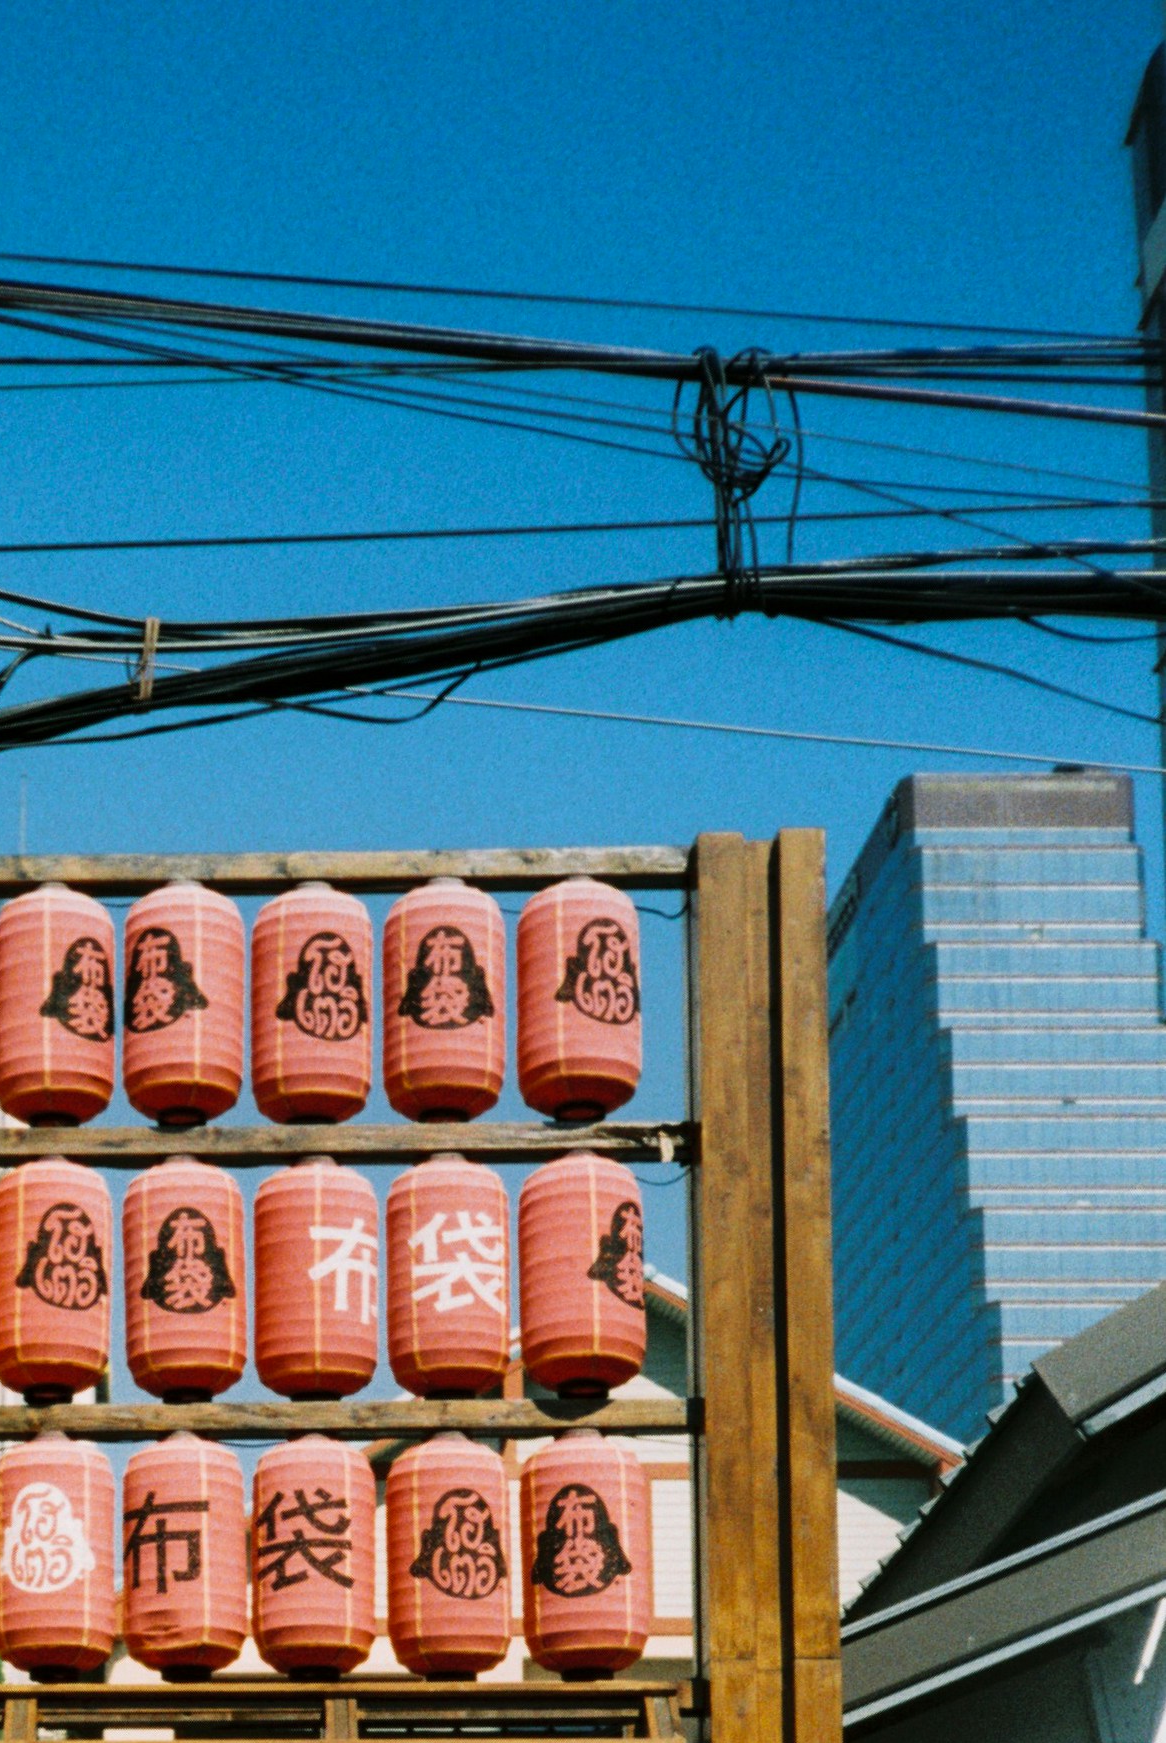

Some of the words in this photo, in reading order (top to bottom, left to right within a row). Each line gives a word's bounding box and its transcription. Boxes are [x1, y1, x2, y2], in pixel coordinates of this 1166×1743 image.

[67, 941, 108, 1039] 布袋
[132, 934, 176, 1029] 布袋
[420, 931, 470, 1025] 布袋
[164, 1212, 214, 1308] 布袋
[408, 1210, 508, 1315] 袋
[123, 1491, 210, 1594] 布
[256, 1488, 355, 1592] 袋
[553, 1490, 604, 1593] 布袋
